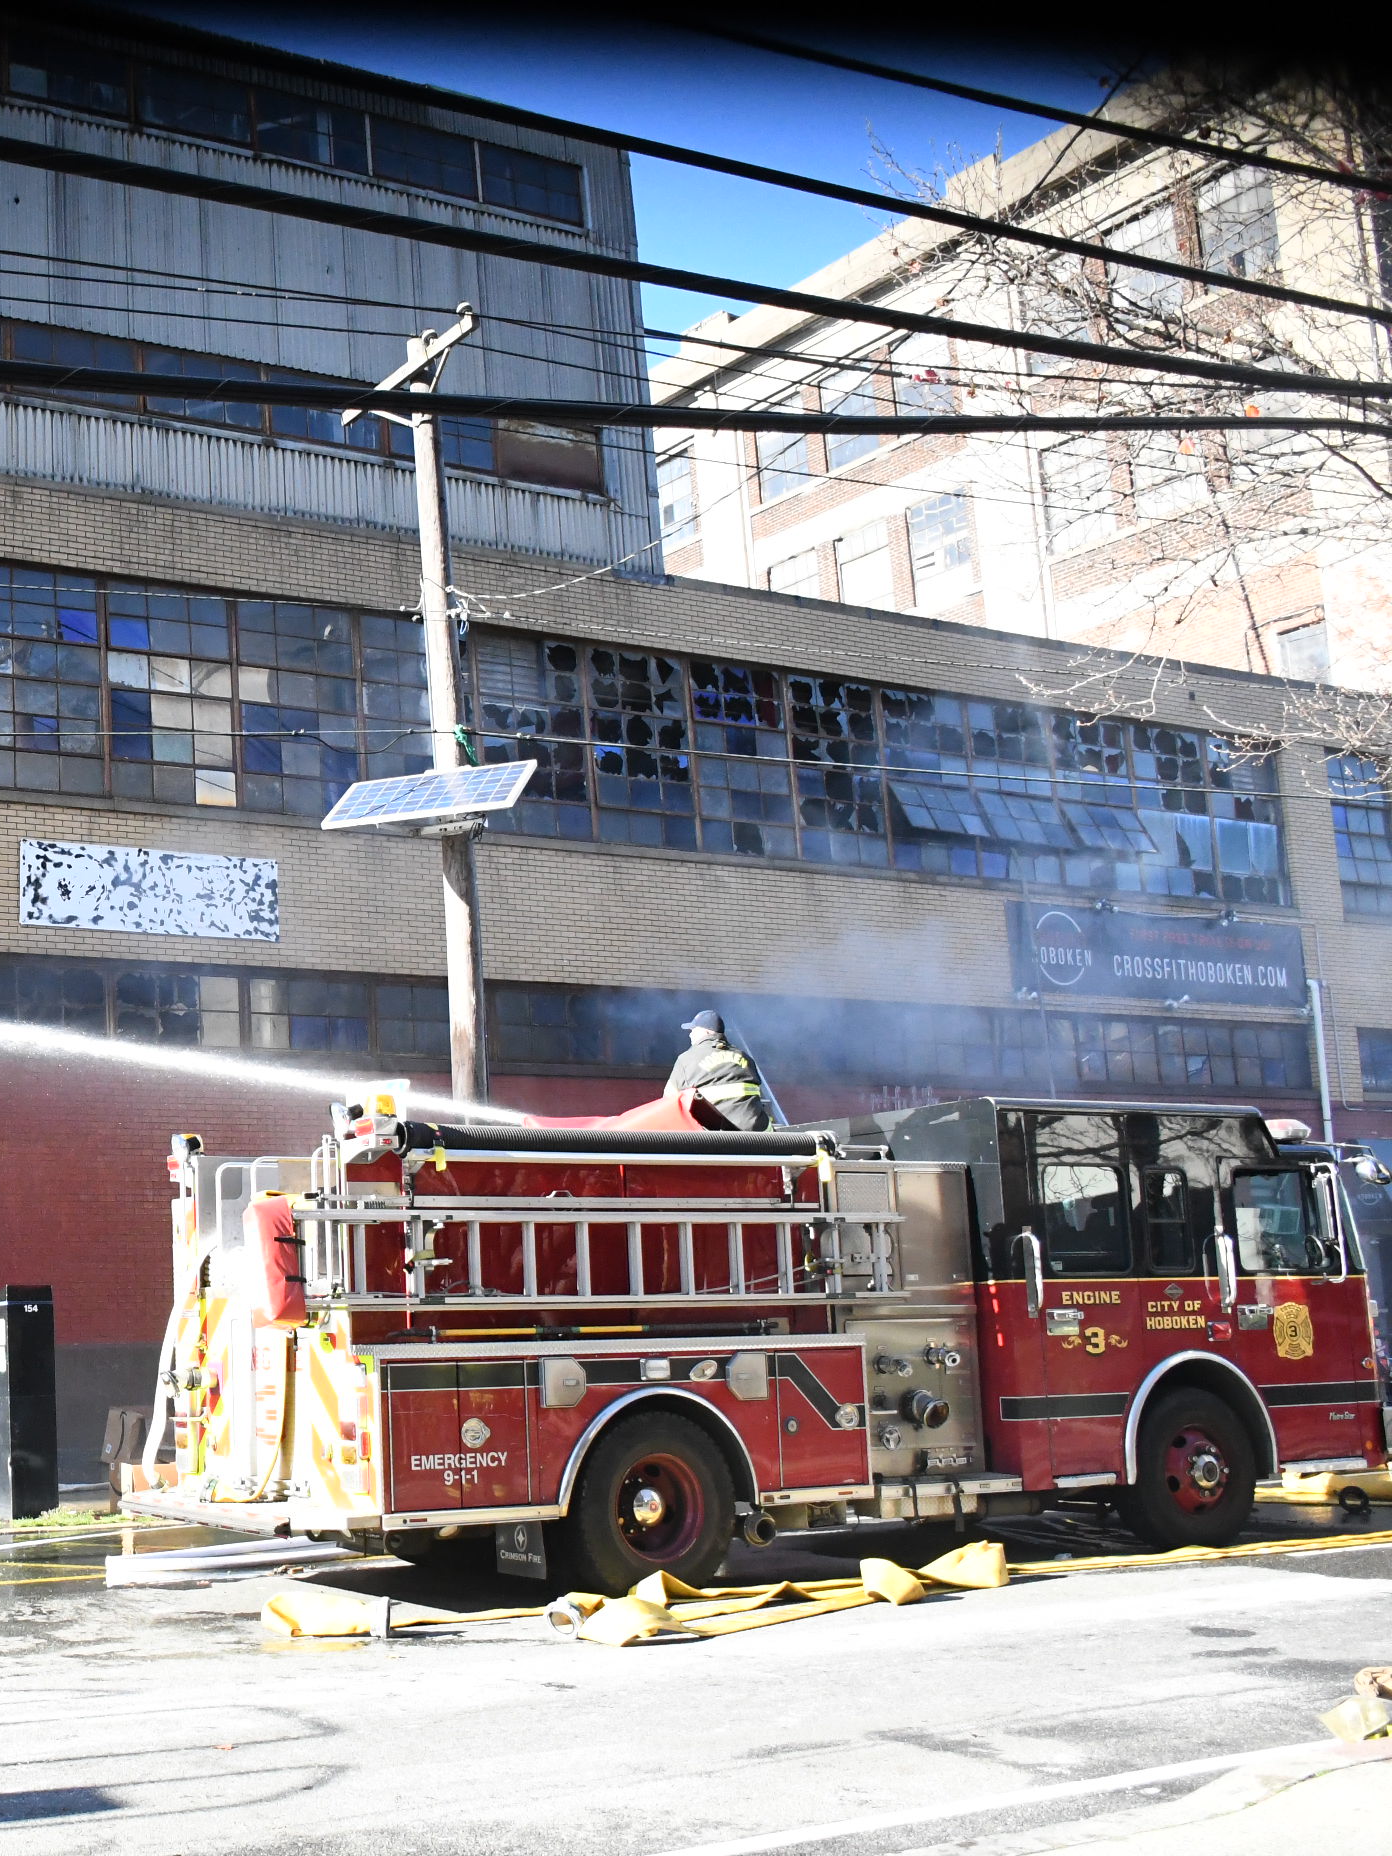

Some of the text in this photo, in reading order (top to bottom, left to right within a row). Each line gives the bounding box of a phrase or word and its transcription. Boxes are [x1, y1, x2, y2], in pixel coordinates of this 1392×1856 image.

[1113, 954, 1288, 988] CROSSFITHOBOKEN.COM
[1061, 1291, 1121, 1305] ENGINE
[23, 1304, 39, 1313] 154
[1147, 1301, 1202, 1312] CITY OF
[1146, 1316, 1206, 1330] HOBOKEN
[1288, 1325, 1298, 1338] 3
[1084, 1326, 1106, 1355] 3
[411, 1451, 508, 1471] EMERGENCY
[444, 1469, 478, 1486] 9-1-1
